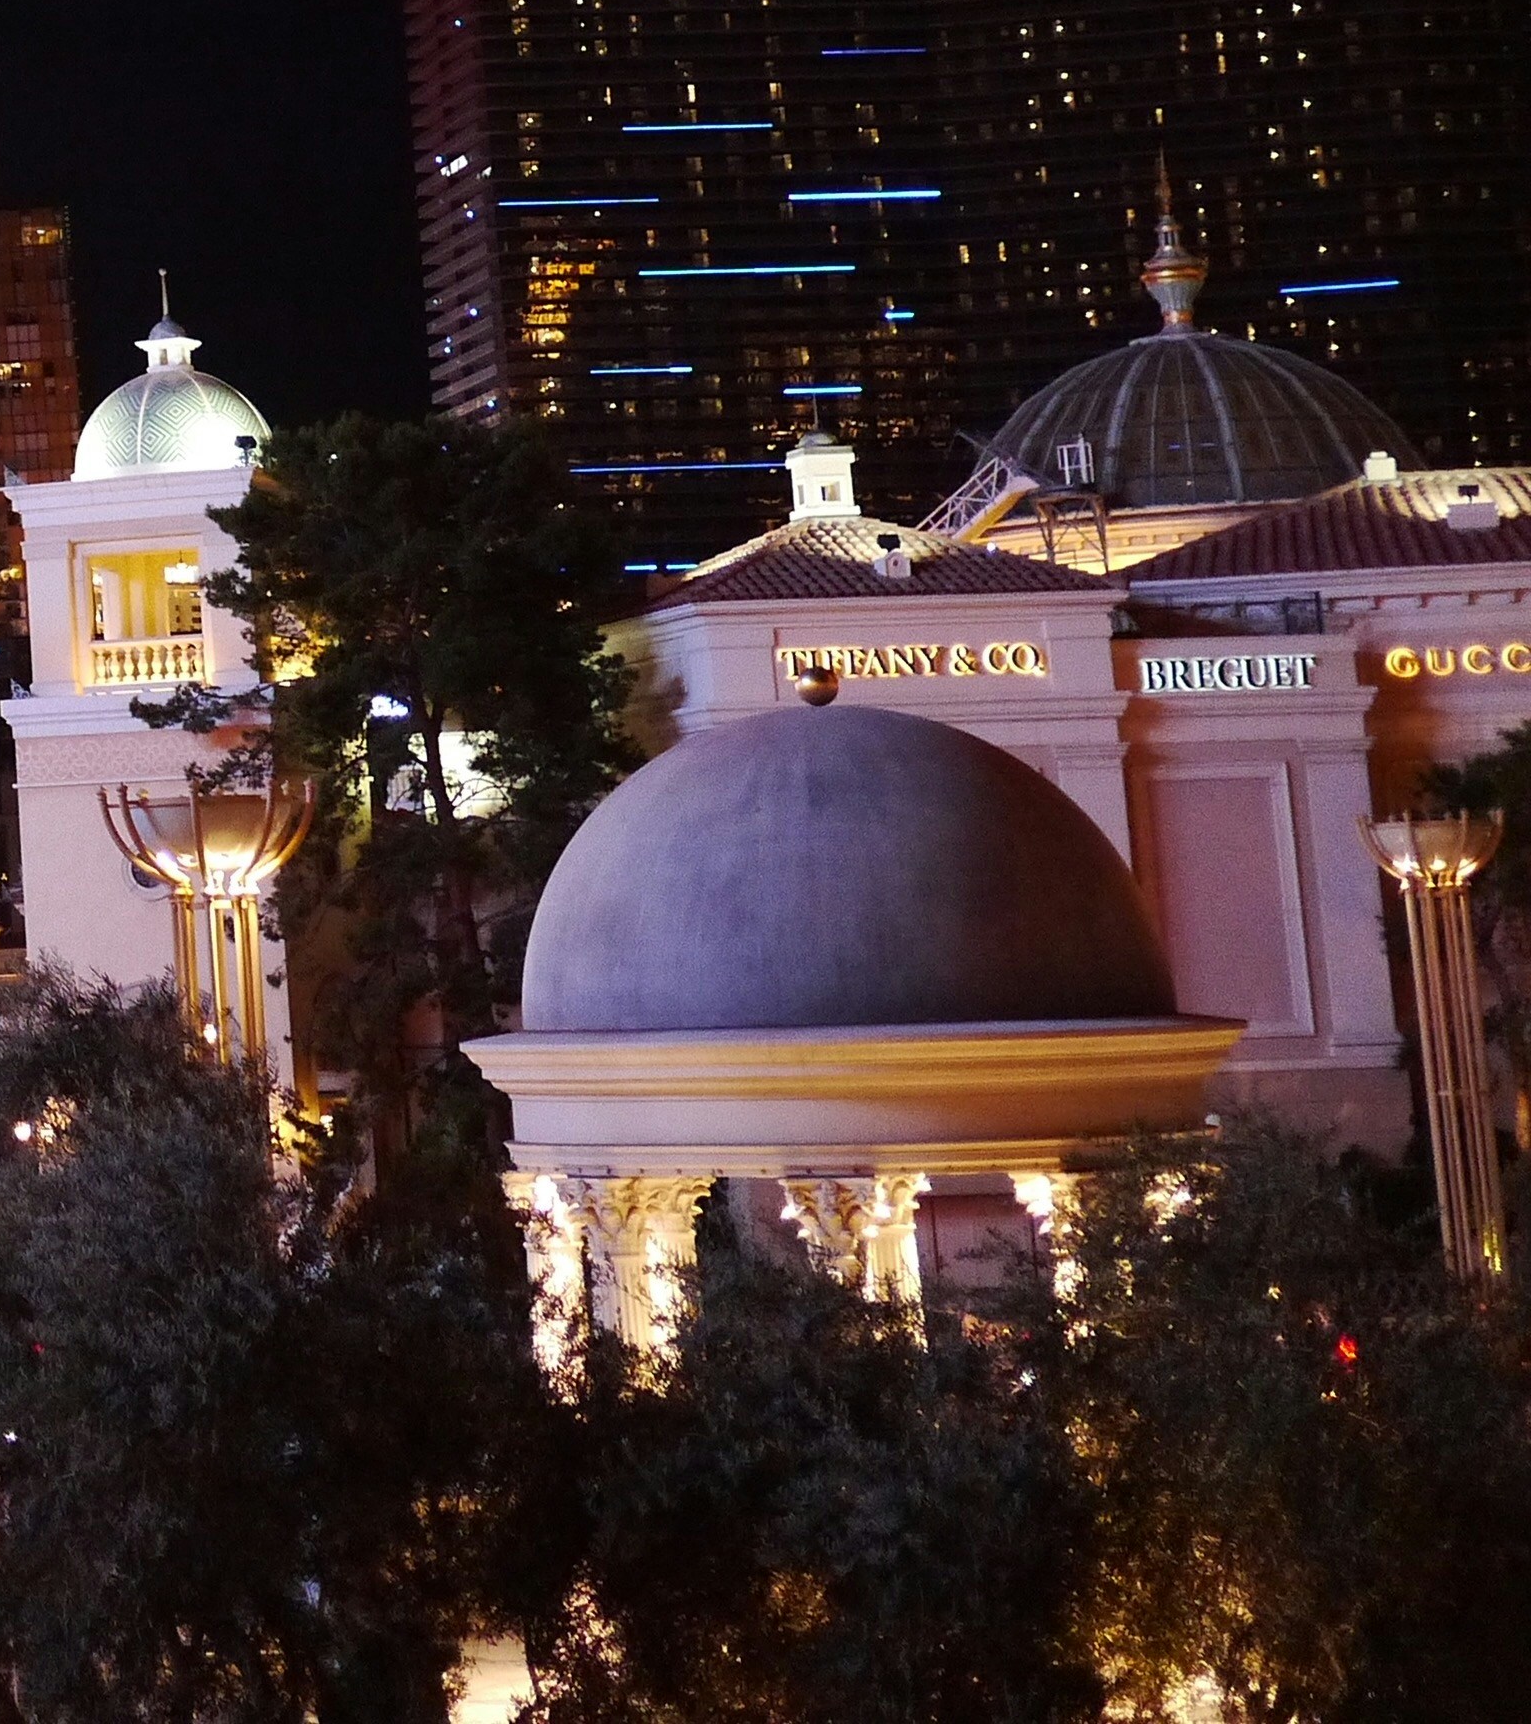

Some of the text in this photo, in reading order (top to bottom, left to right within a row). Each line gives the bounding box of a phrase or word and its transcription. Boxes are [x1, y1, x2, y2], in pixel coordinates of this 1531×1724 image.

[777, 644, 943, 679] TIFFANY
[949, 643, 977, 677] &
[1140, 652, 1317, 694] BREGUET
[1385, 641, 1531, 679] GUCC
